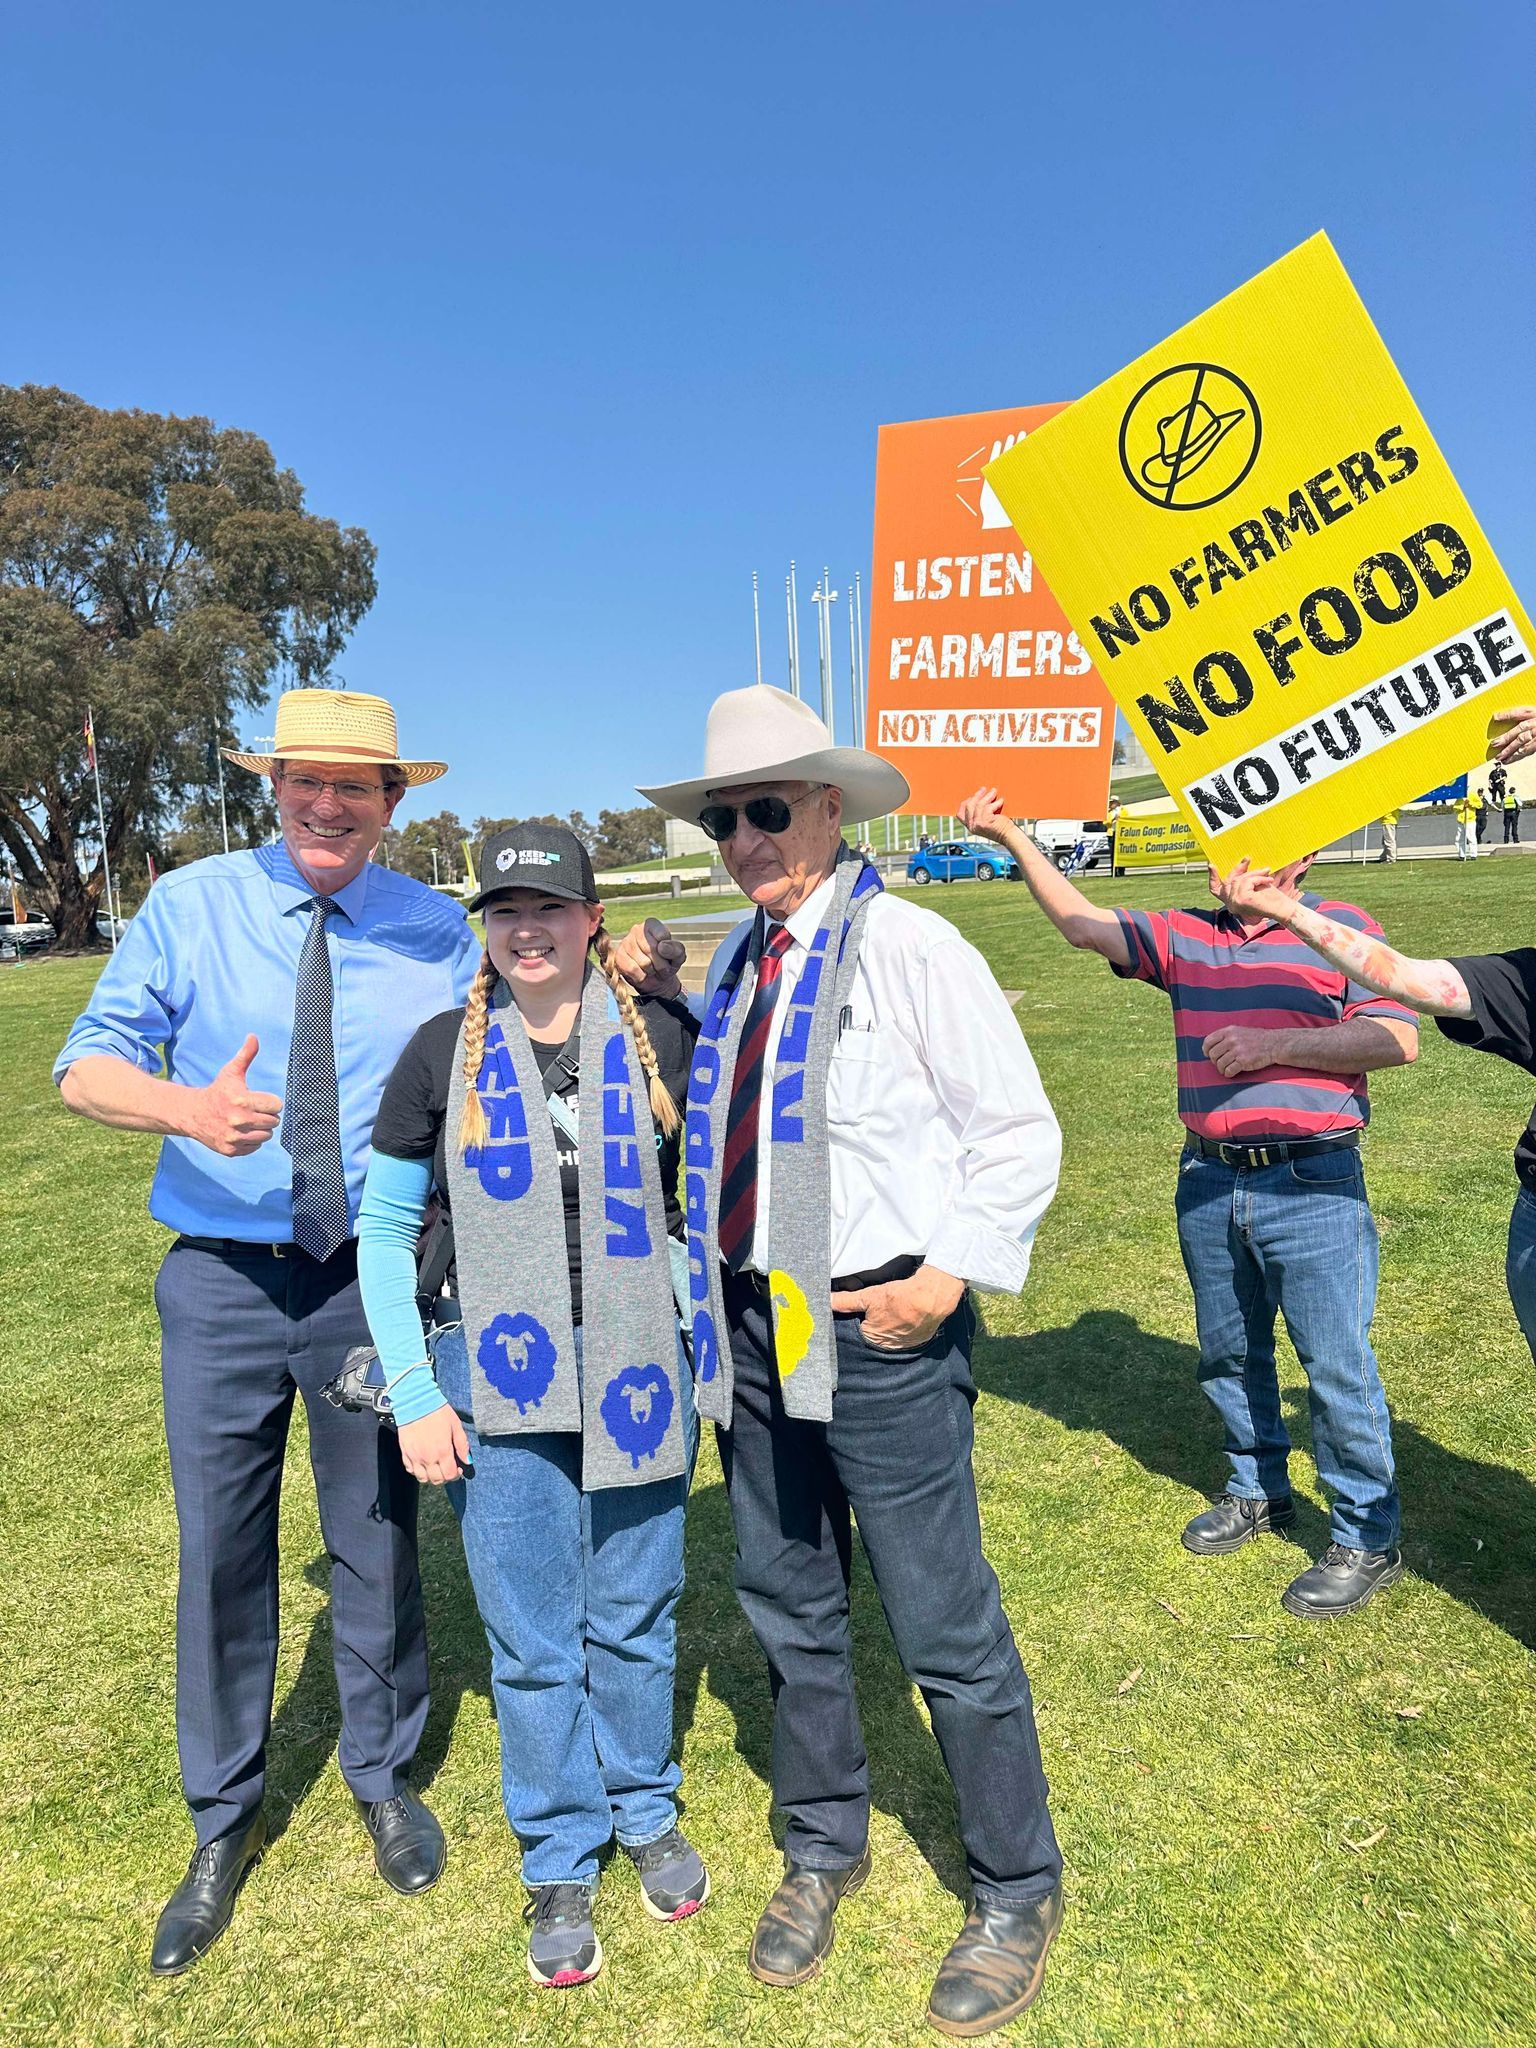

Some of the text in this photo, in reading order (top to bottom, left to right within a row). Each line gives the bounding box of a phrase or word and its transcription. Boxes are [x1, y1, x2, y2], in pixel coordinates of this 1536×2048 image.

[1089, 425, 1419, 659] NO FARMERS
[893, 550, 1033, 602] LISTEN
[889, 630, 1093, 680] FARMERS
[1135, 523, 1472, 754] NO FOOD
[881, 712, 1096, 742] NOT ACTIVISTS
[1189, 616, 1527, 832] NO FUTURE
[1119, 843, 1137, 853] Truth
[1145, 840, 1196, 853] Compassion
[1120, 827, 1141, 837] Falun
[1142, 826, 1166, 837] Gong:
[686, 950, 742, 1383] SUPPOR
